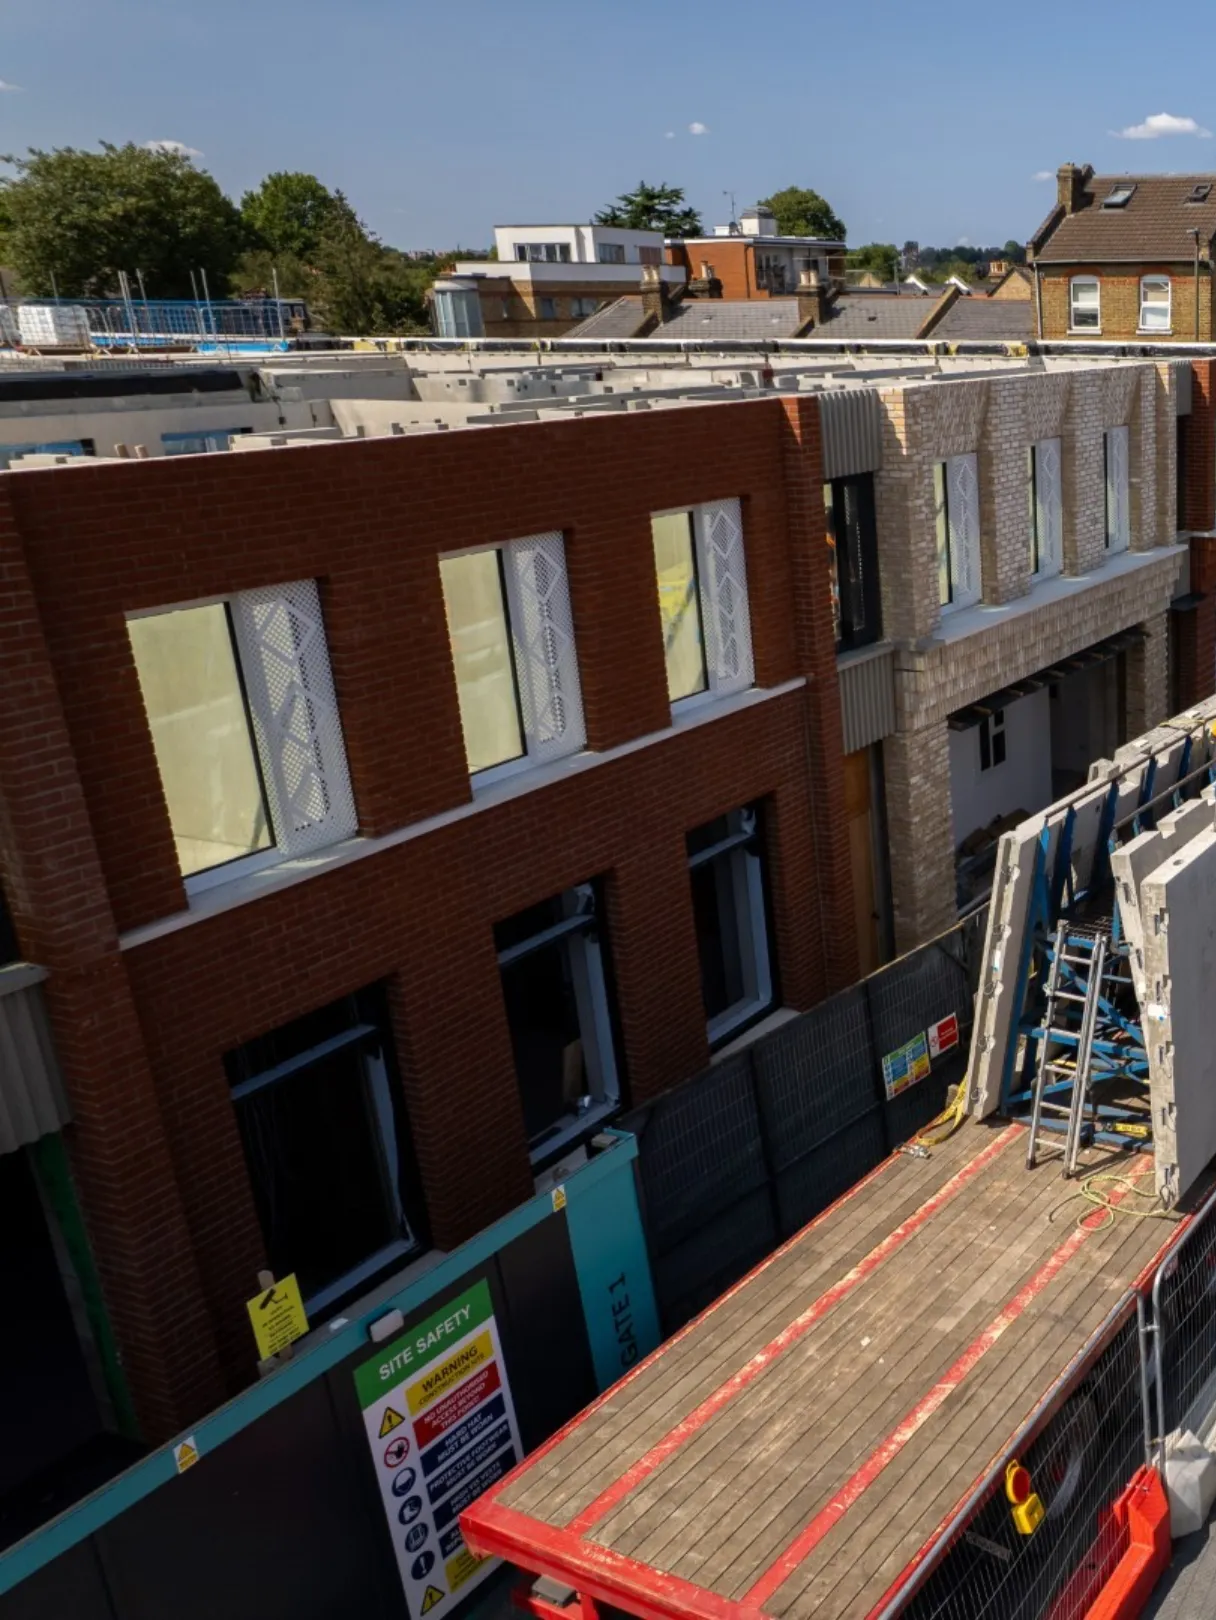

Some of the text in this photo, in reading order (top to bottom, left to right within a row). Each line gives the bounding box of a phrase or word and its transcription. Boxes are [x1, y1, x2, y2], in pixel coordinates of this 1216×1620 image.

[379, 1303, 472, 1381] SITE SAFETY
[608, 1271, 639, 1367] GATE 1
[422, 1344, 478, 1393] WARNING
[437, 1411, 493, 1463] MUST BE WORN
[445, 1411, 483, 1446] HARD HAT
